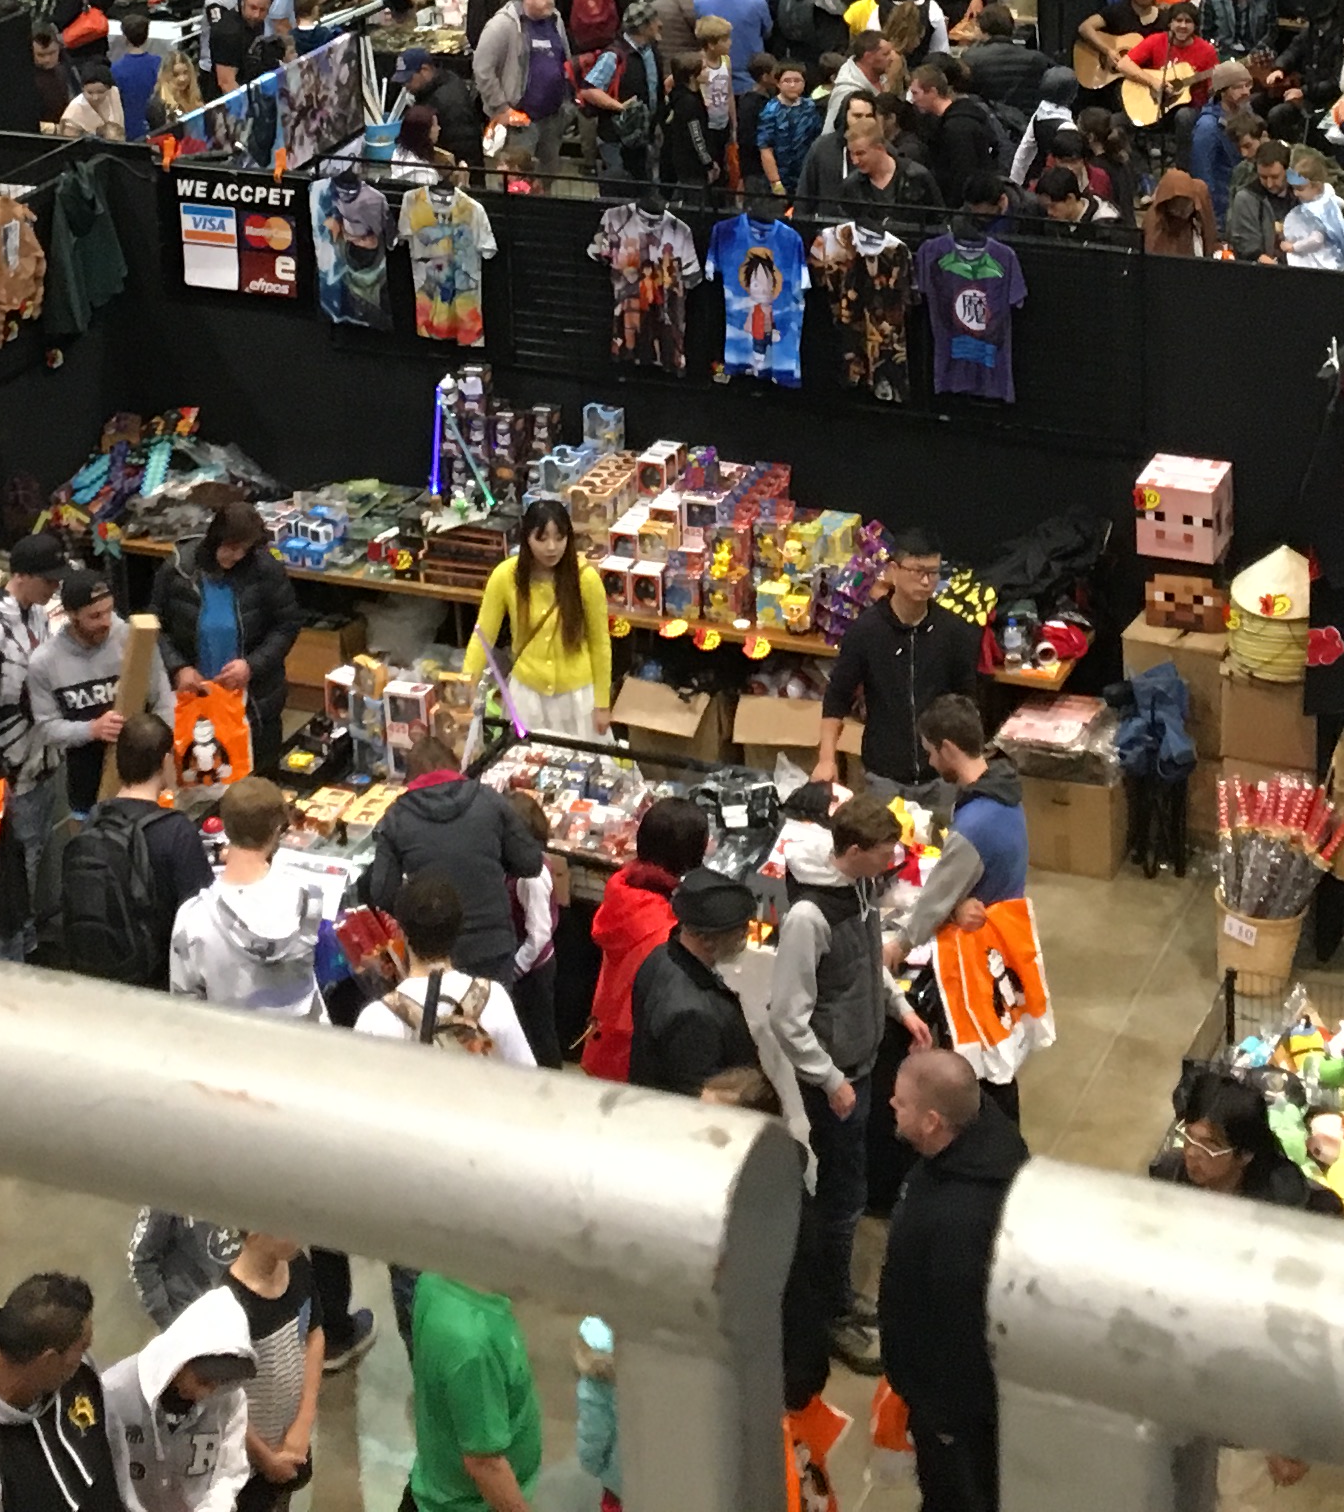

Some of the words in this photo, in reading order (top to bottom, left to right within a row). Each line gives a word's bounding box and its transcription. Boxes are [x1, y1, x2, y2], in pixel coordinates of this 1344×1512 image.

[177, 178, 208, 198] WE
[211, 182, 295, 207] ACCPET
[191, 216, 226, 232] VISA
